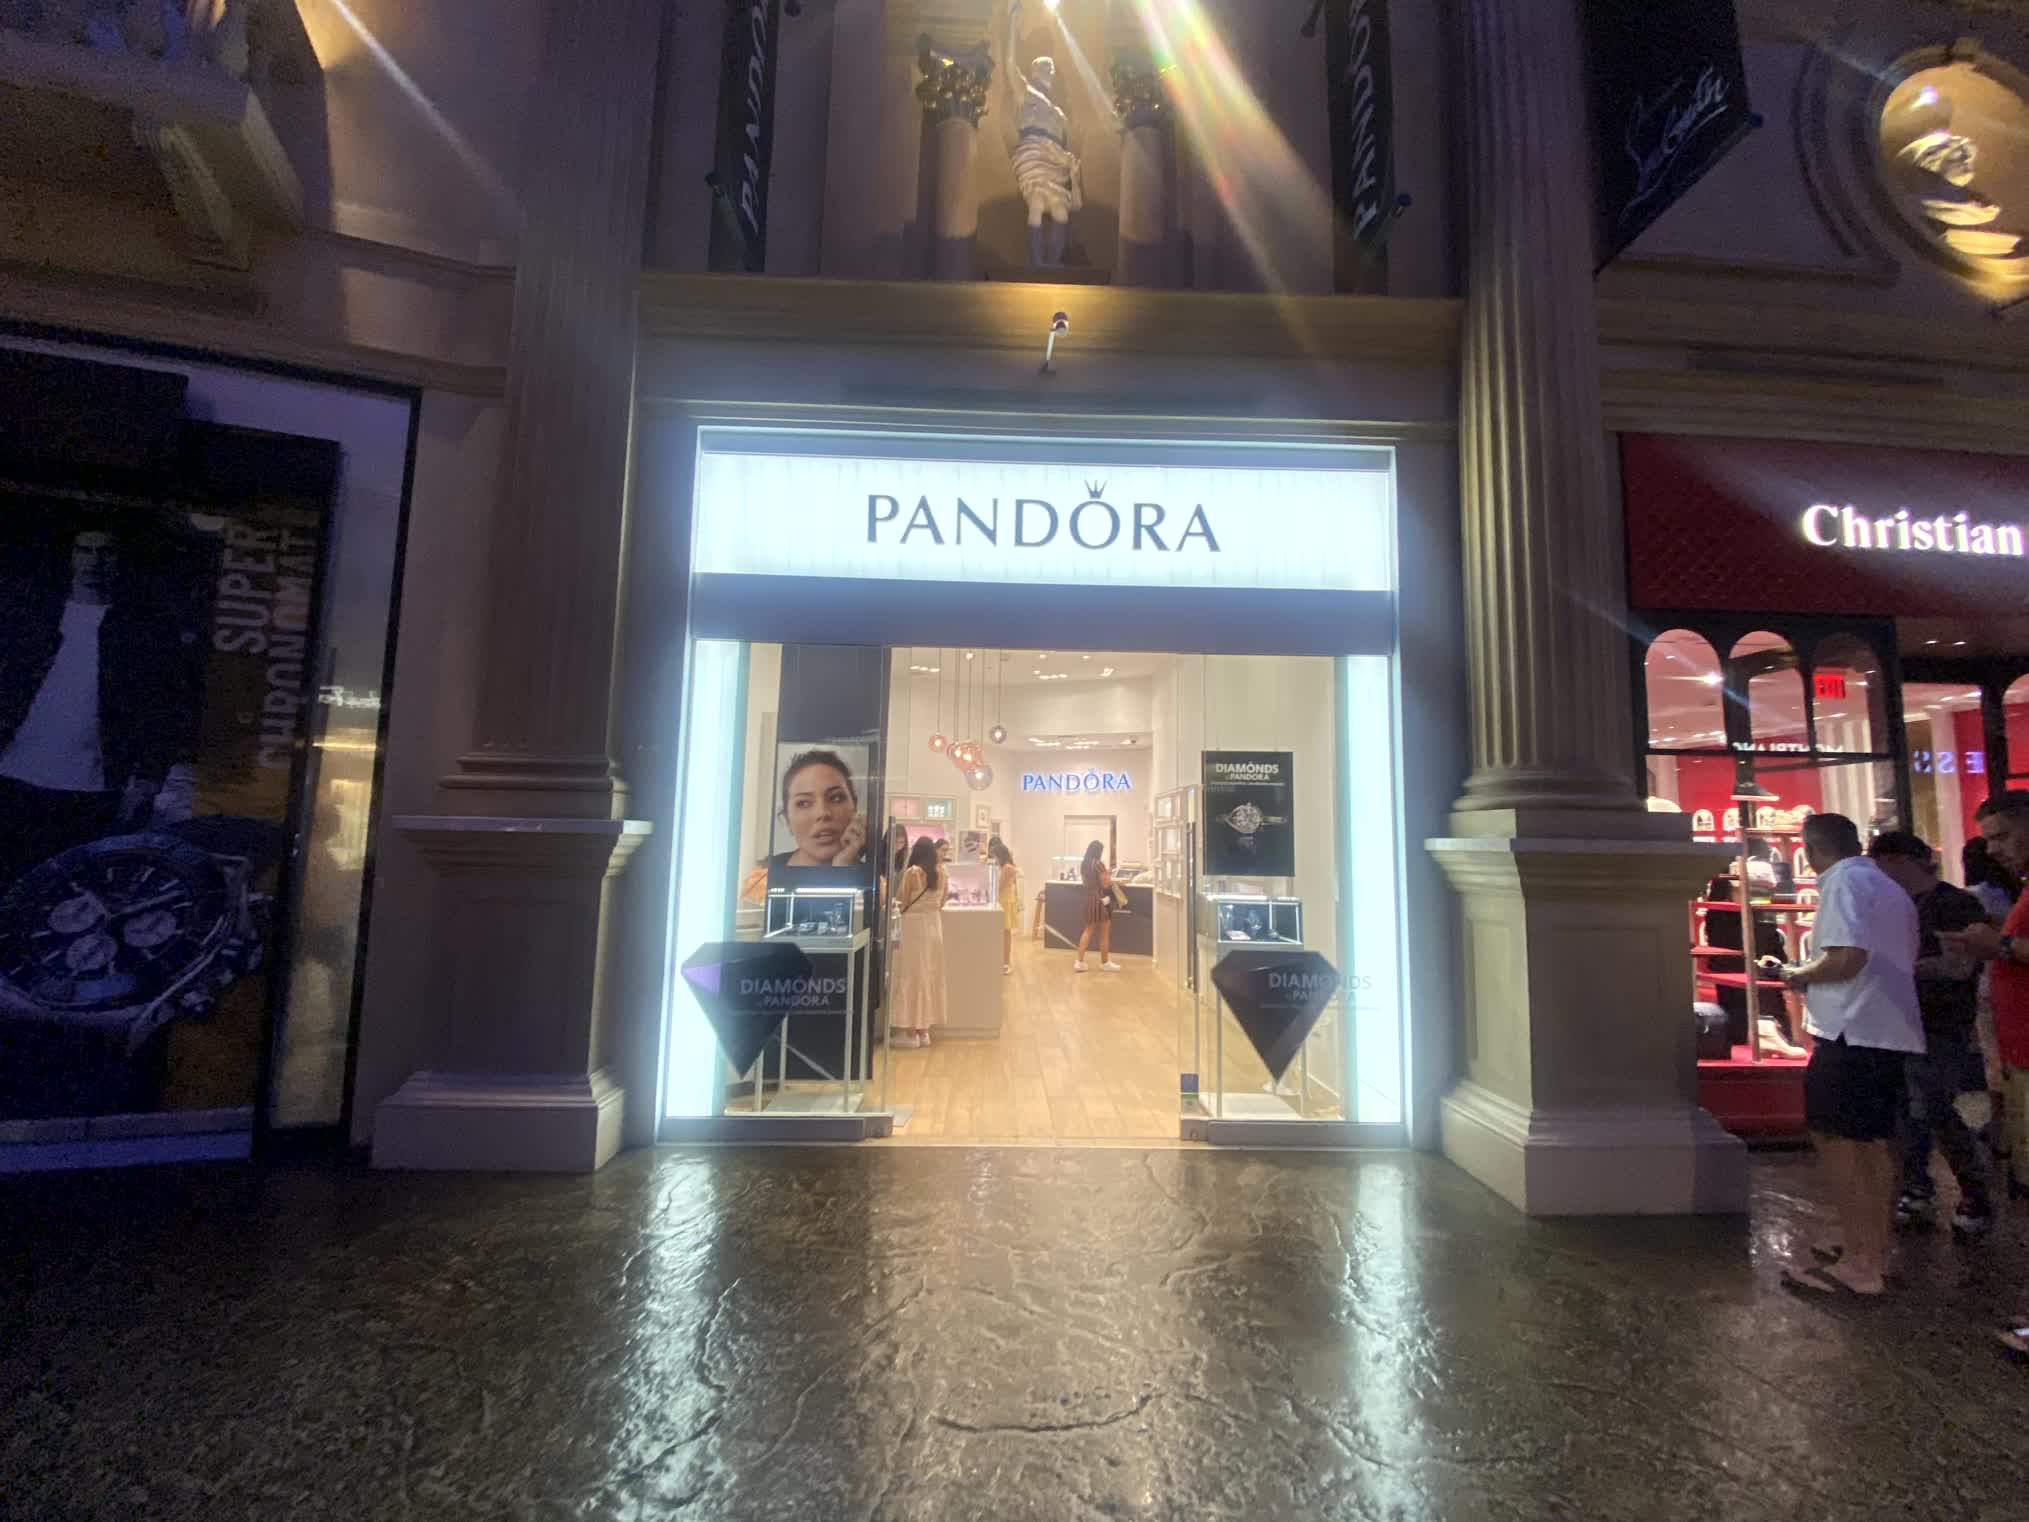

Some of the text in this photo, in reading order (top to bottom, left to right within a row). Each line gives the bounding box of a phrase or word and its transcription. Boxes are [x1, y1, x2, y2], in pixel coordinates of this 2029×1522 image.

[867, 493, 1221, 553] PANDORA
[1801, 503, 2025, 556] Christian
[212, 525, 279, 656] SUPER
[1215, 761, 1280, 774] DIAMONDS
[1023, 772, 1131, 791] PANDORA
[740, 977, 847, 995] DIAMONDS
[763, 995, 830, 1008] PANDORA
